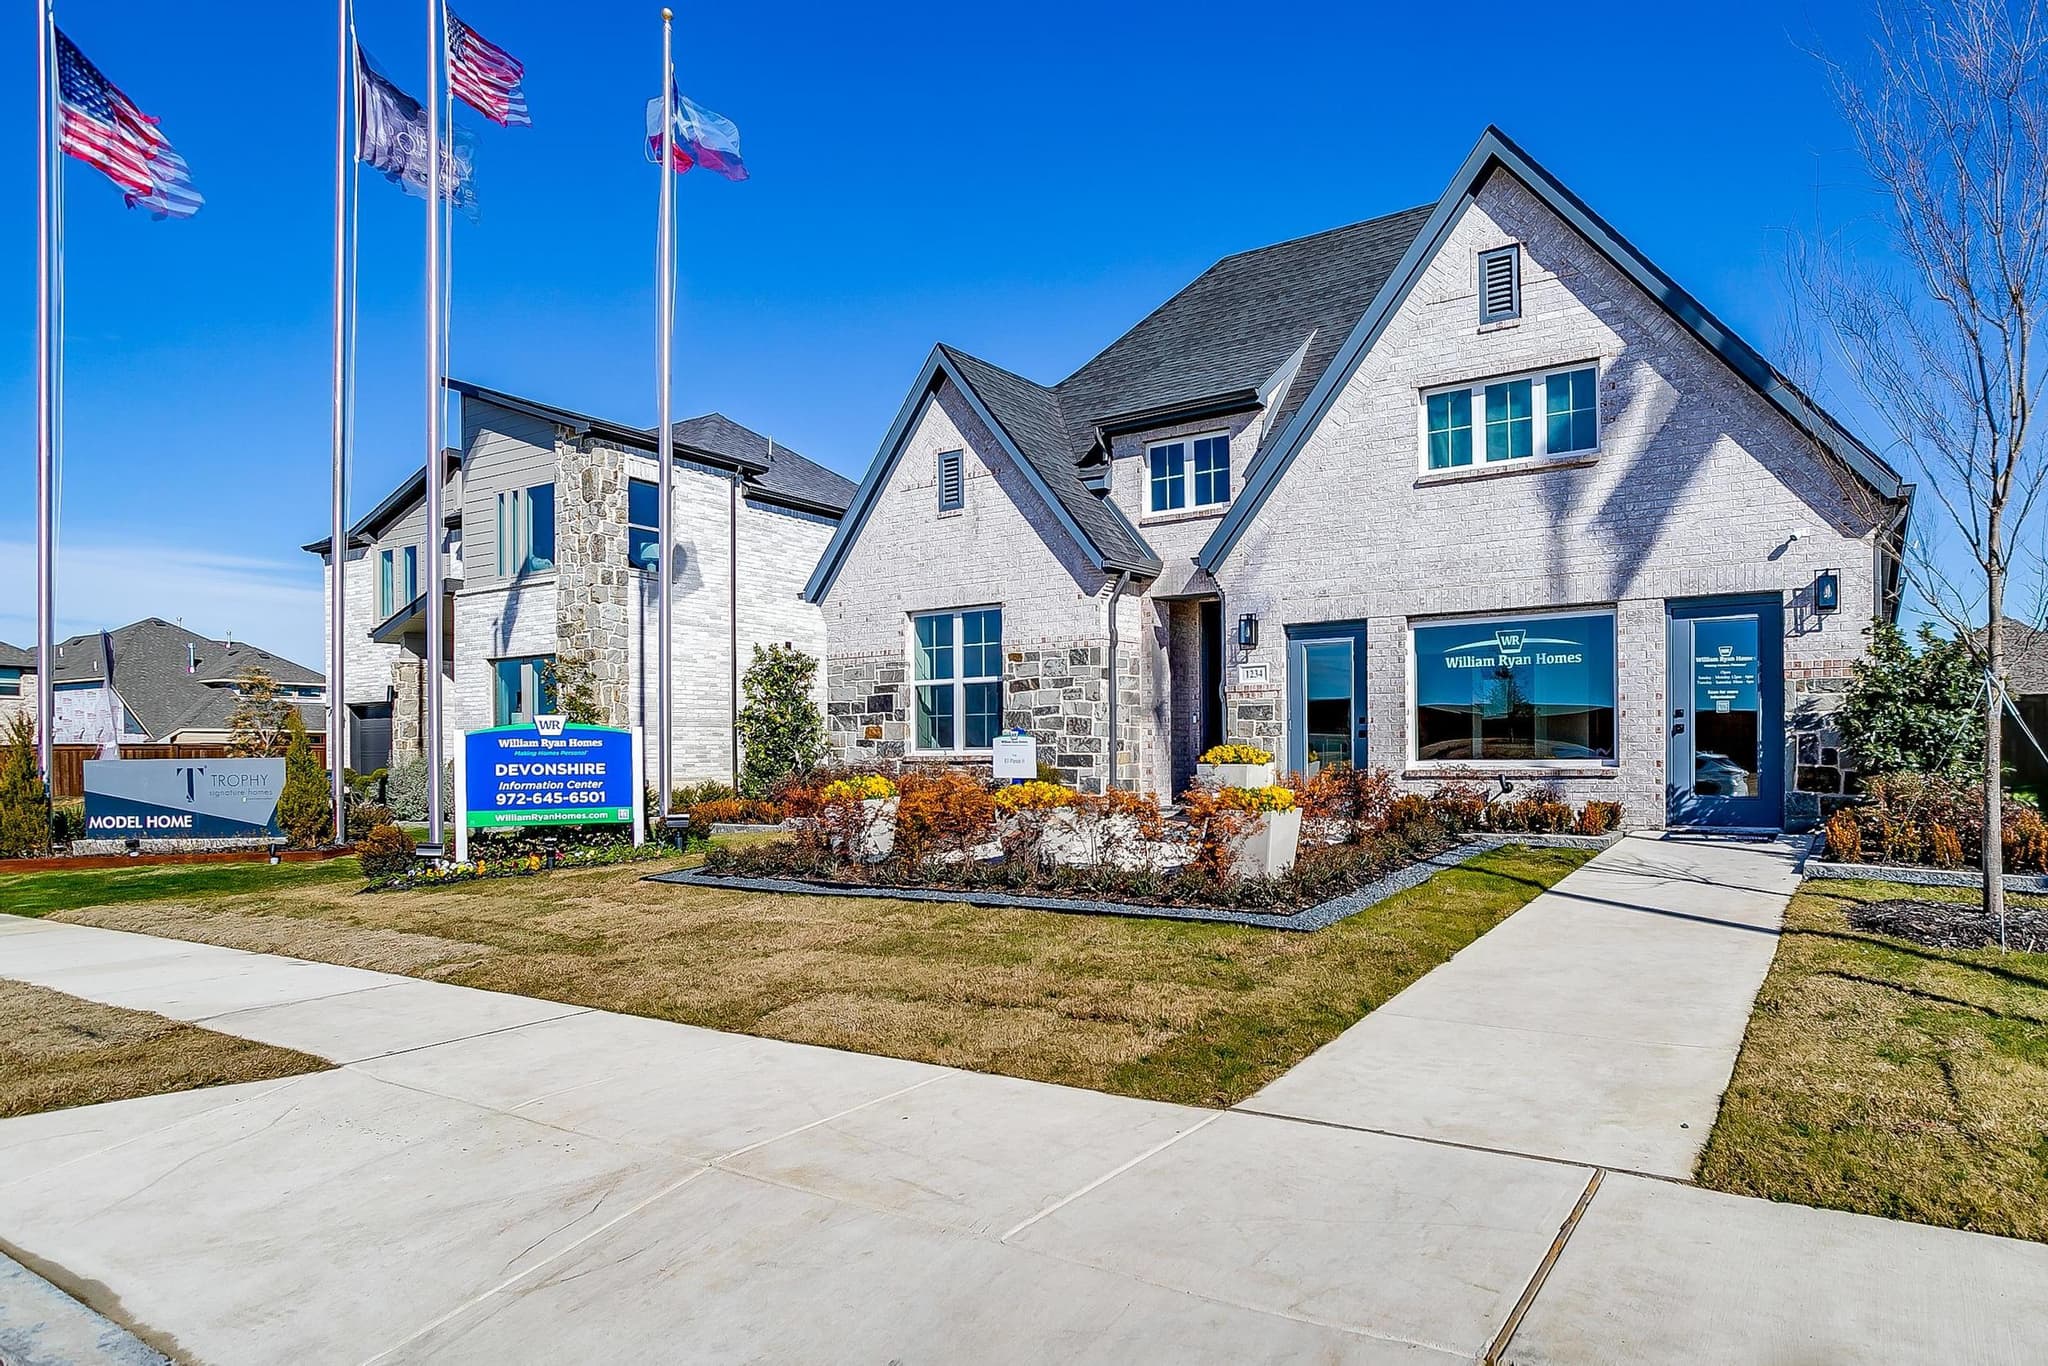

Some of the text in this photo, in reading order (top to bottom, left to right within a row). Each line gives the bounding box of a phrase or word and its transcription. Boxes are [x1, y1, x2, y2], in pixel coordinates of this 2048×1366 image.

[1501, 636, 1520, 645] WR
[1445, 653, 1582, 669] William Ryan Homes
[1246, 669, 1263, 679] 1234
[539, 720, 561, 730] WR
[498, 738, 603, 749] William Ryan Homes
[495, 763, 606, 777] DEVONSHIRE
[211, 774, 268, 787] TROPHY
[499, 780, 603, 791] Information Center
[209, 788, 273, 797] signature homes
[496, 792, 606, 805] 972-645-6501
[88, 815, 193, 829] MODEL HOME
[495, 812, 608, 822] WilliamRyanHomes.com
